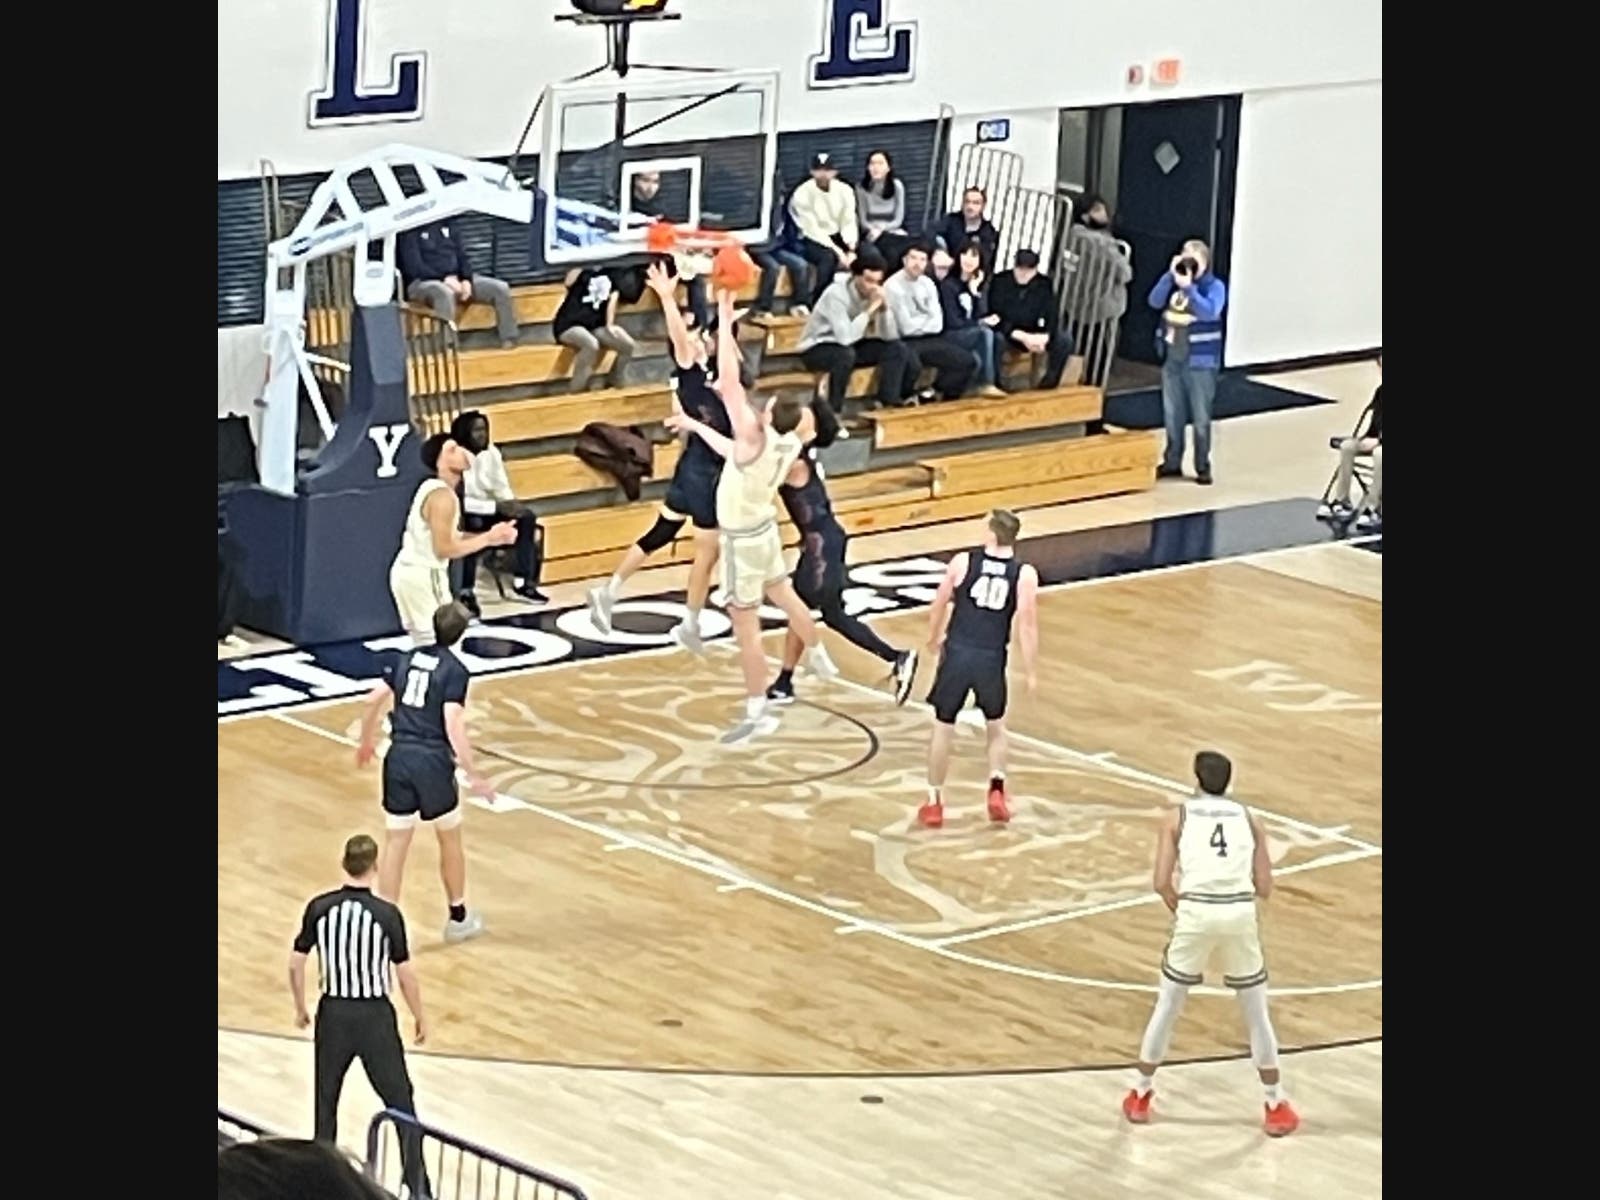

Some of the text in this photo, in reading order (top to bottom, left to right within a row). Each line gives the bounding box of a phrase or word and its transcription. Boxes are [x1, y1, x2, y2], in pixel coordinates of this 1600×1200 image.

[368, 423, 410, 478] Y
[970, 574, 1010, 611] 40
[401, 668, 430, 709] 11
[1210, 822, 1228, 858] 4
